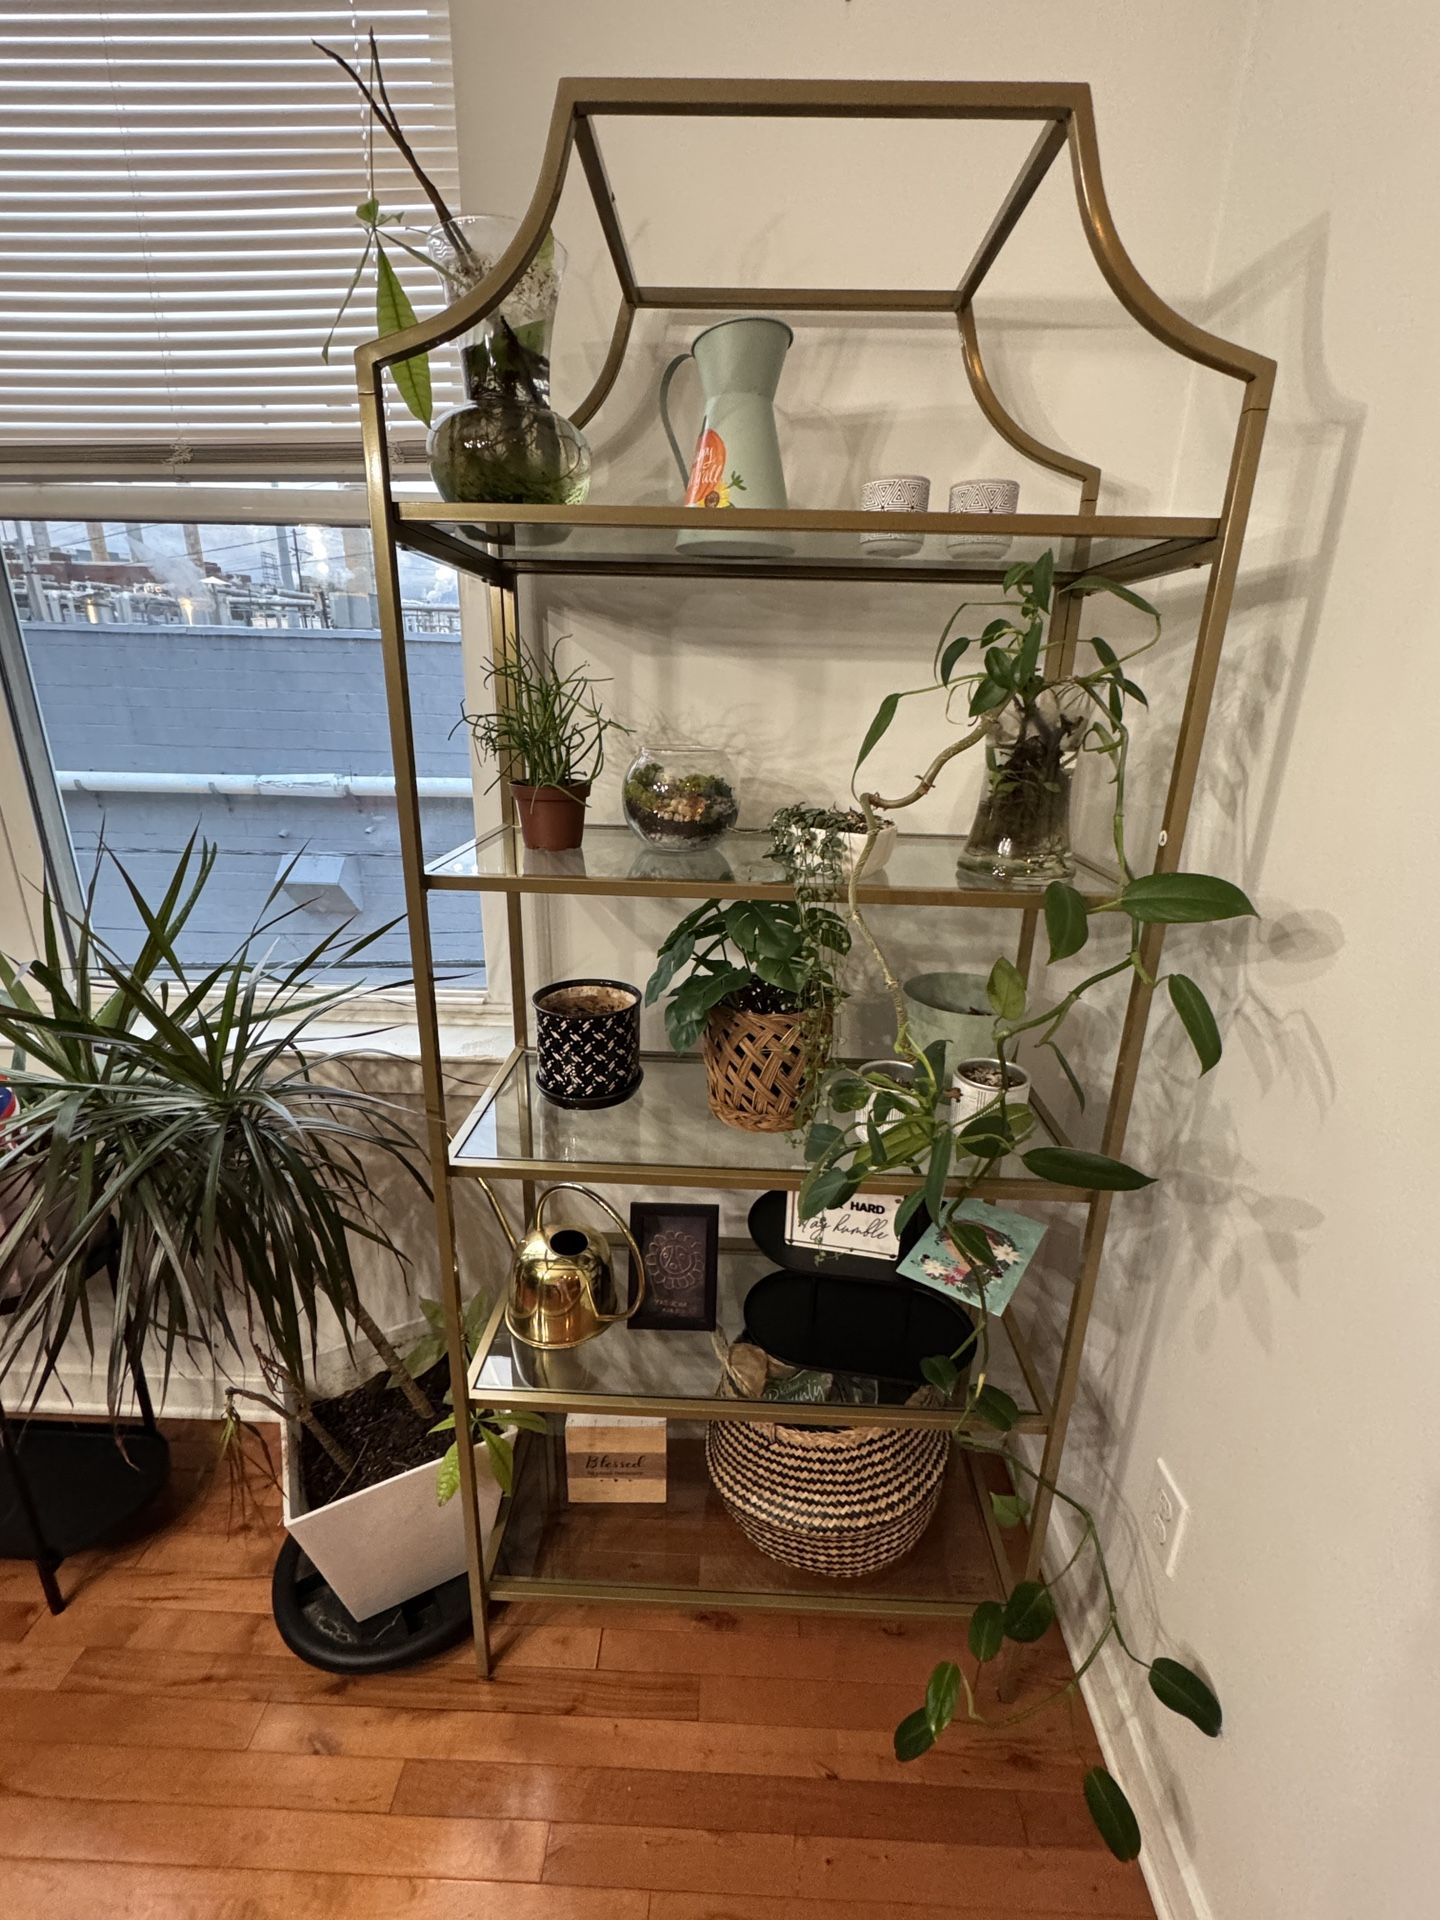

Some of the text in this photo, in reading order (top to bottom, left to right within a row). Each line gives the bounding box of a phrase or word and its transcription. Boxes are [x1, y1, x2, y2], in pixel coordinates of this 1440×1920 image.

[850, 1201, 886, 1215] HARD
[798, 1213, 890, 1241] tay humble
[585, 1455, 646, 1469] Blessed
